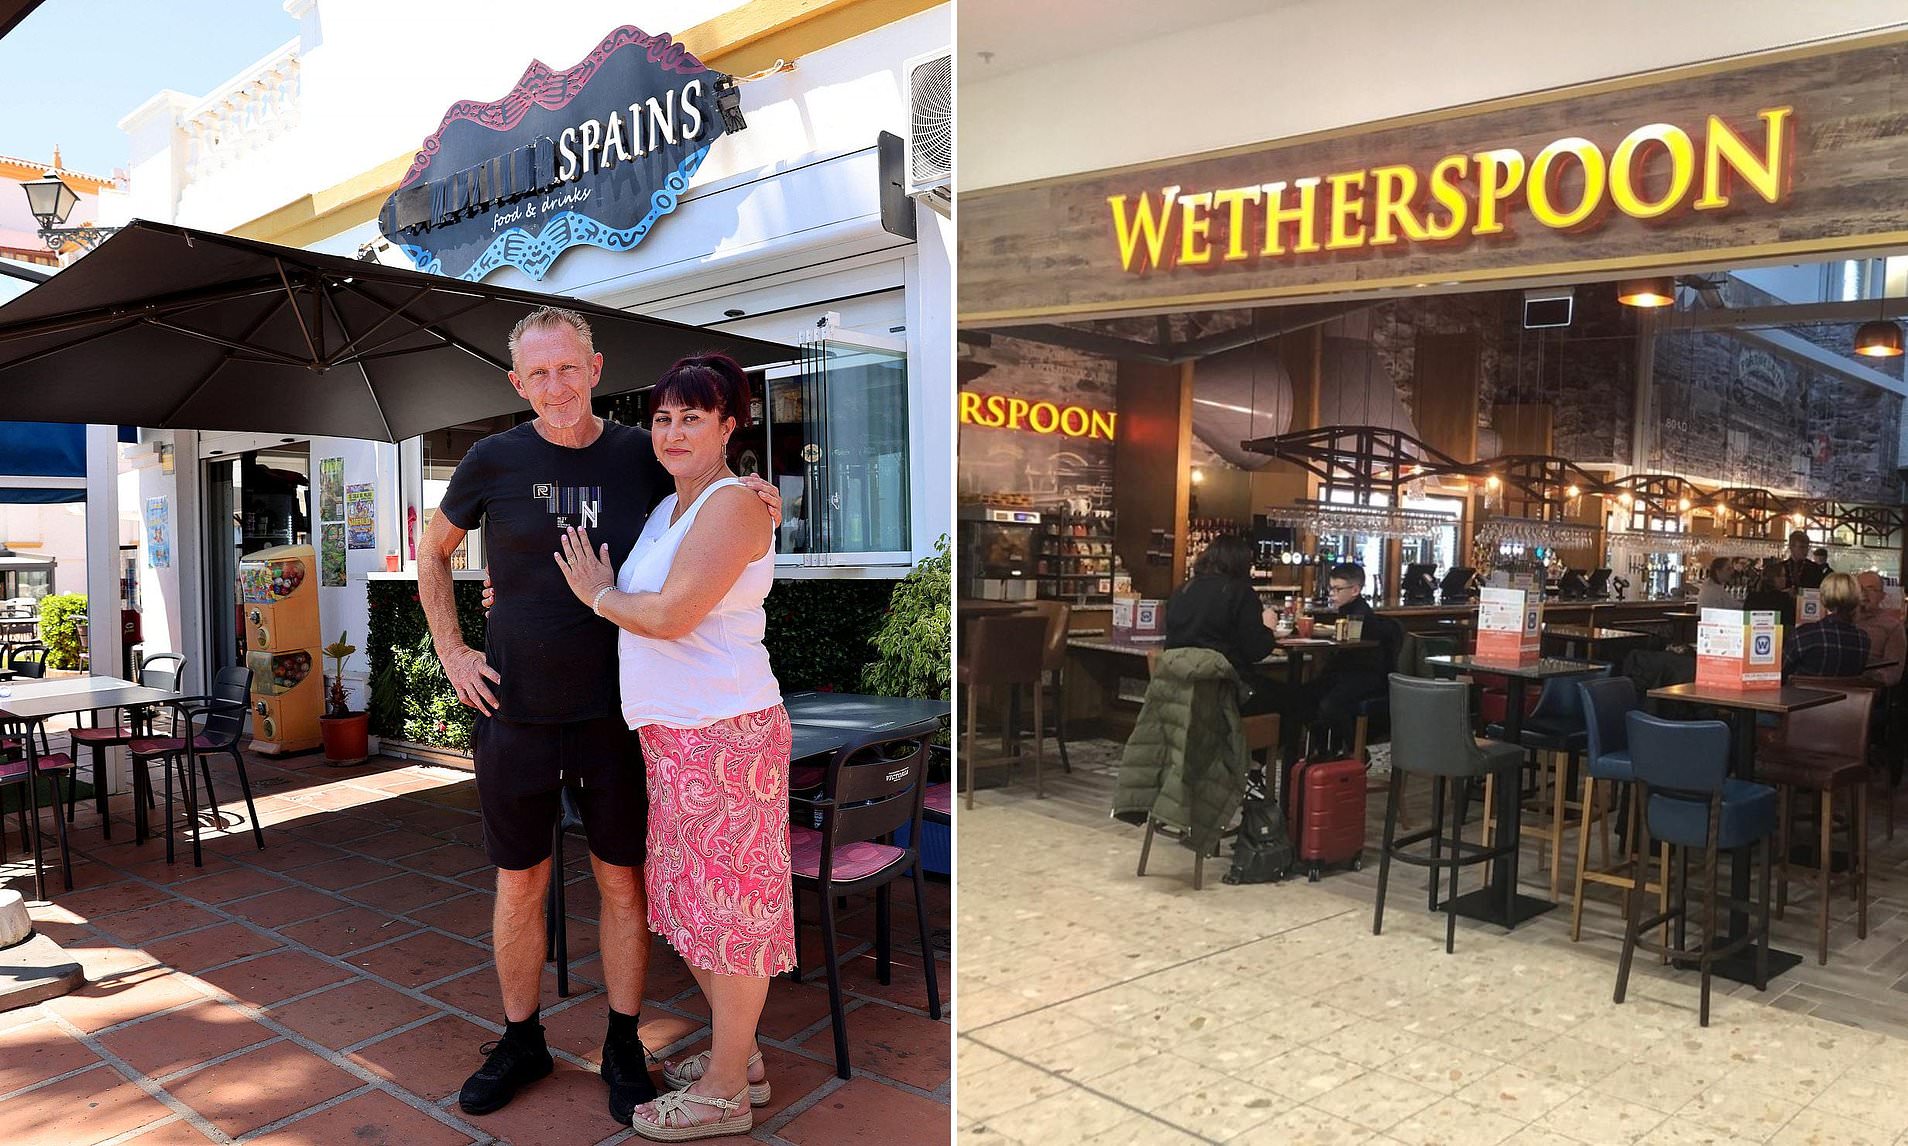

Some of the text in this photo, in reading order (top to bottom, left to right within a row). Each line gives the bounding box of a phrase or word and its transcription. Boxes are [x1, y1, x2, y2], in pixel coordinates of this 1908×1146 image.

[559, 79, 702, 182] SPAINS
[491, 187, 591, 232] food & drinks
[1107, 105, 1793, 272] WETHERSPOON
[959, 391, 1118, 441] RSPOON
[581, 500, 598, 529] N
